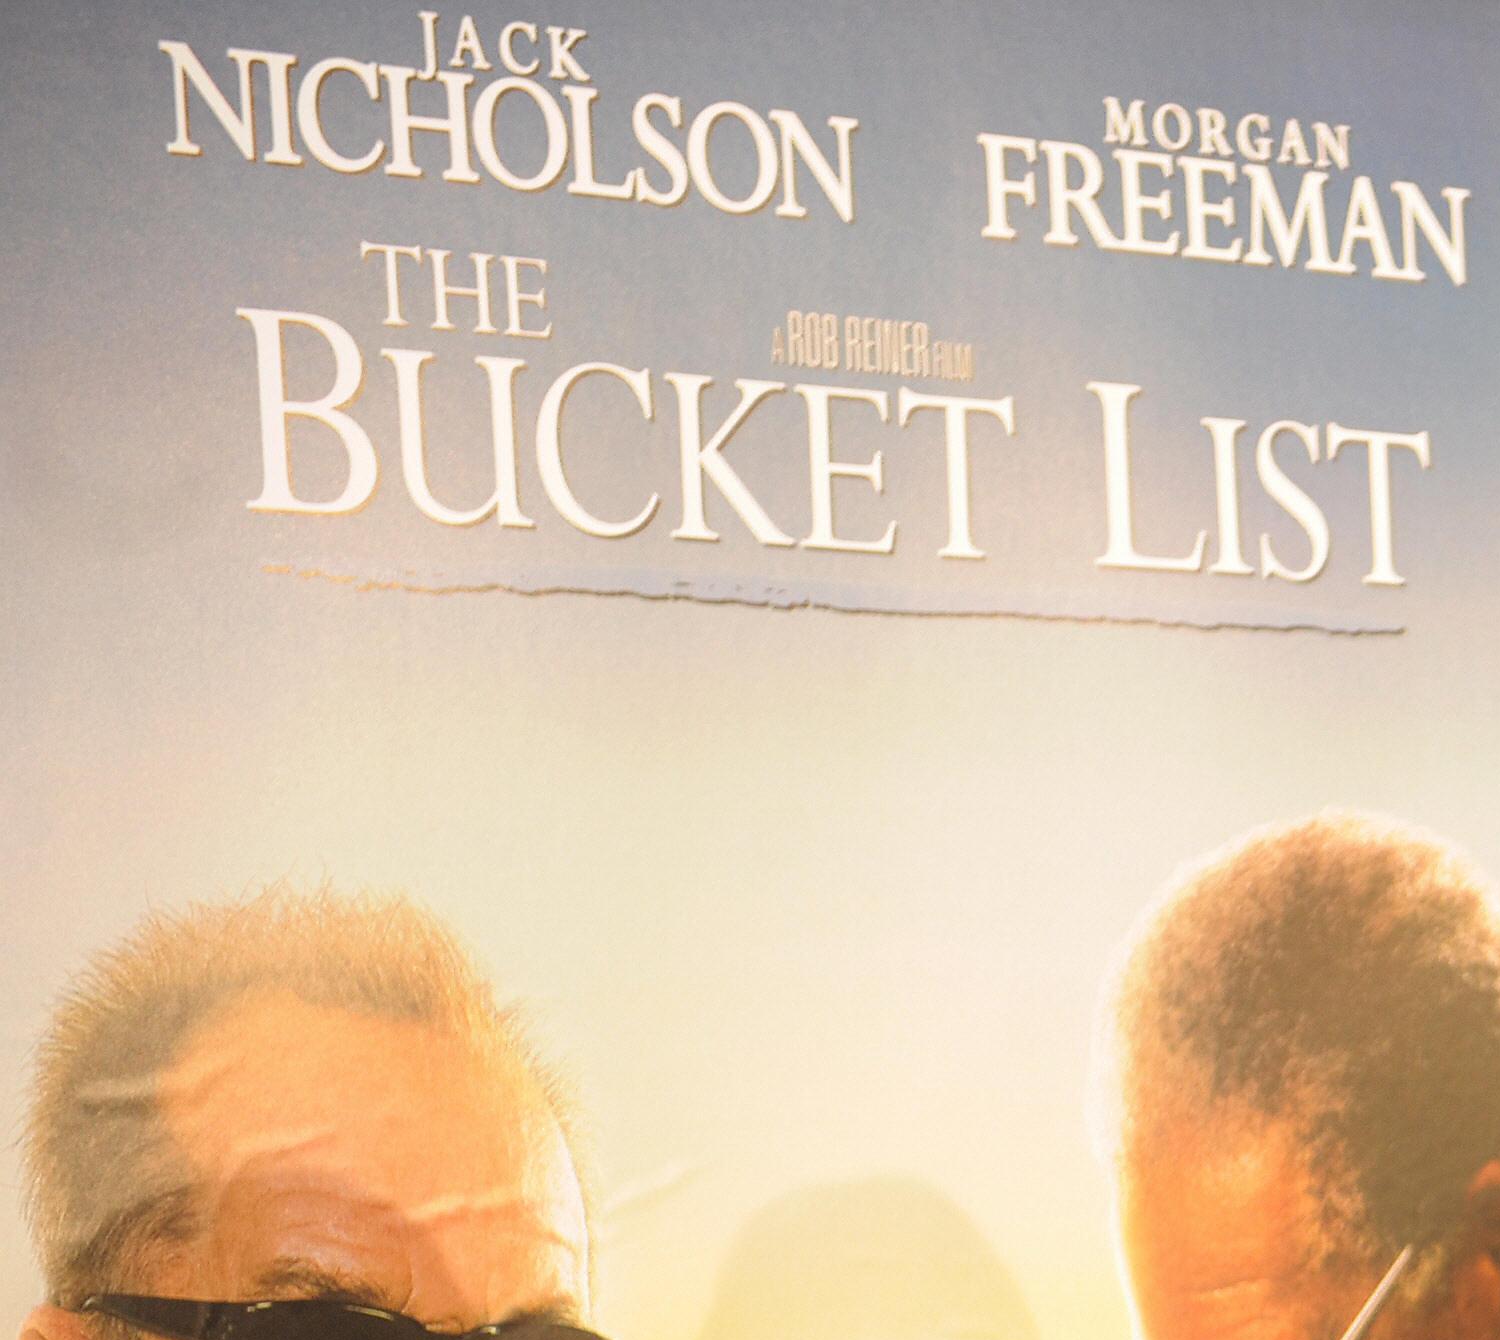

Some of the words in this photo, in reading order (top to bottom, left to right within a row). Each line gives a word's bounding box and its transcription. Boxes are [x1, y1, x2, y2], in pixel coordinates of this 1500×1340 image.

[416, 9, 591, 82] JACK
[157, 39, 861, 224] NICHOLSON
[1101, 95, 1352, 171] MORGAN
[976, 132, 1472, 287] FREEMAN
[359, 240, 553, 339] THE
[770, 325, 786, 366] A
[787, 309, 840, 370] ROB
[844, 315, 931, 378] REINER
[932, 339, 974, 382] FILM
[235, 306, 1016, 560] BUCKET
[1085, 380, 1431, 587] LIST
